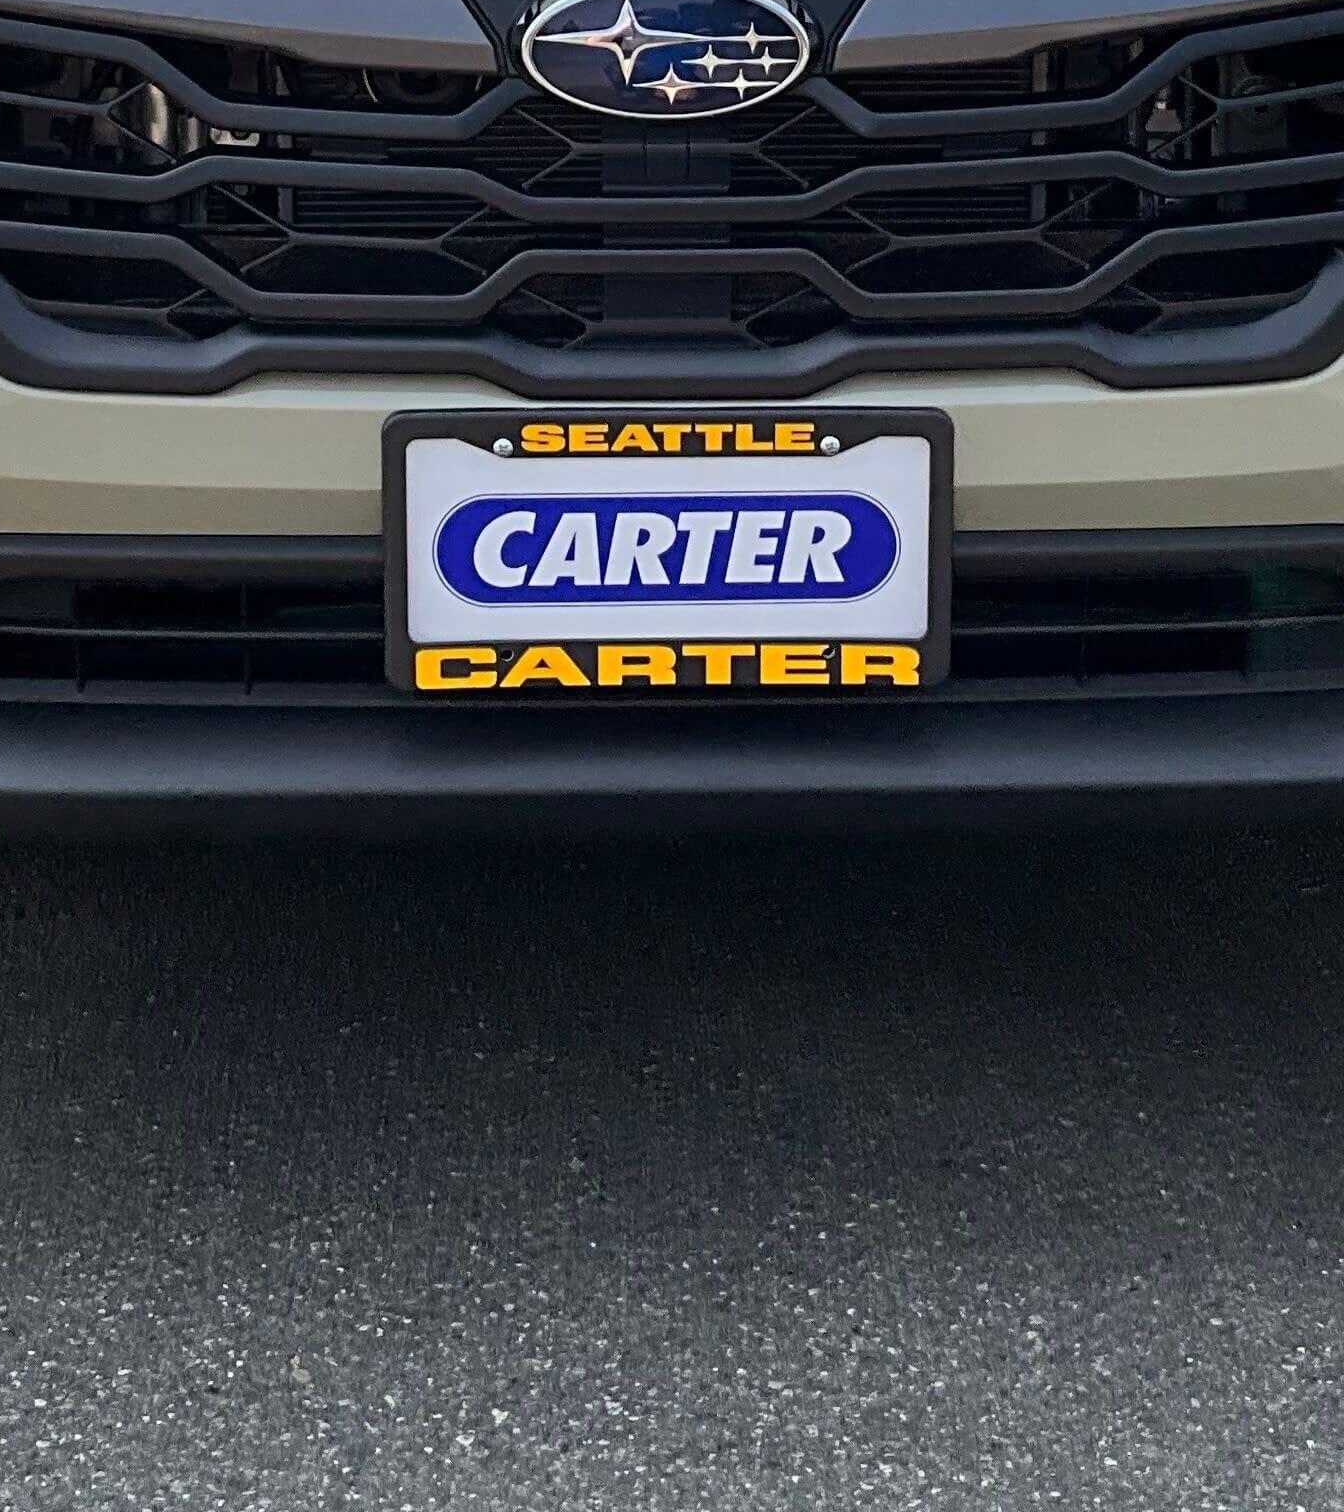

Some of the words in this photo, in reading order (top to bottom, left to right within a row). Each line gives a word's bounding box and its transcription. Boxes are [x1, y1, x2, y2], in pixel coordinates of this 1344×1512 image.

[520, 423, 816, 452] SEATTLE
[472, 510, 852, 589] CARTER
[415, 644, 921, 690] CARTER
